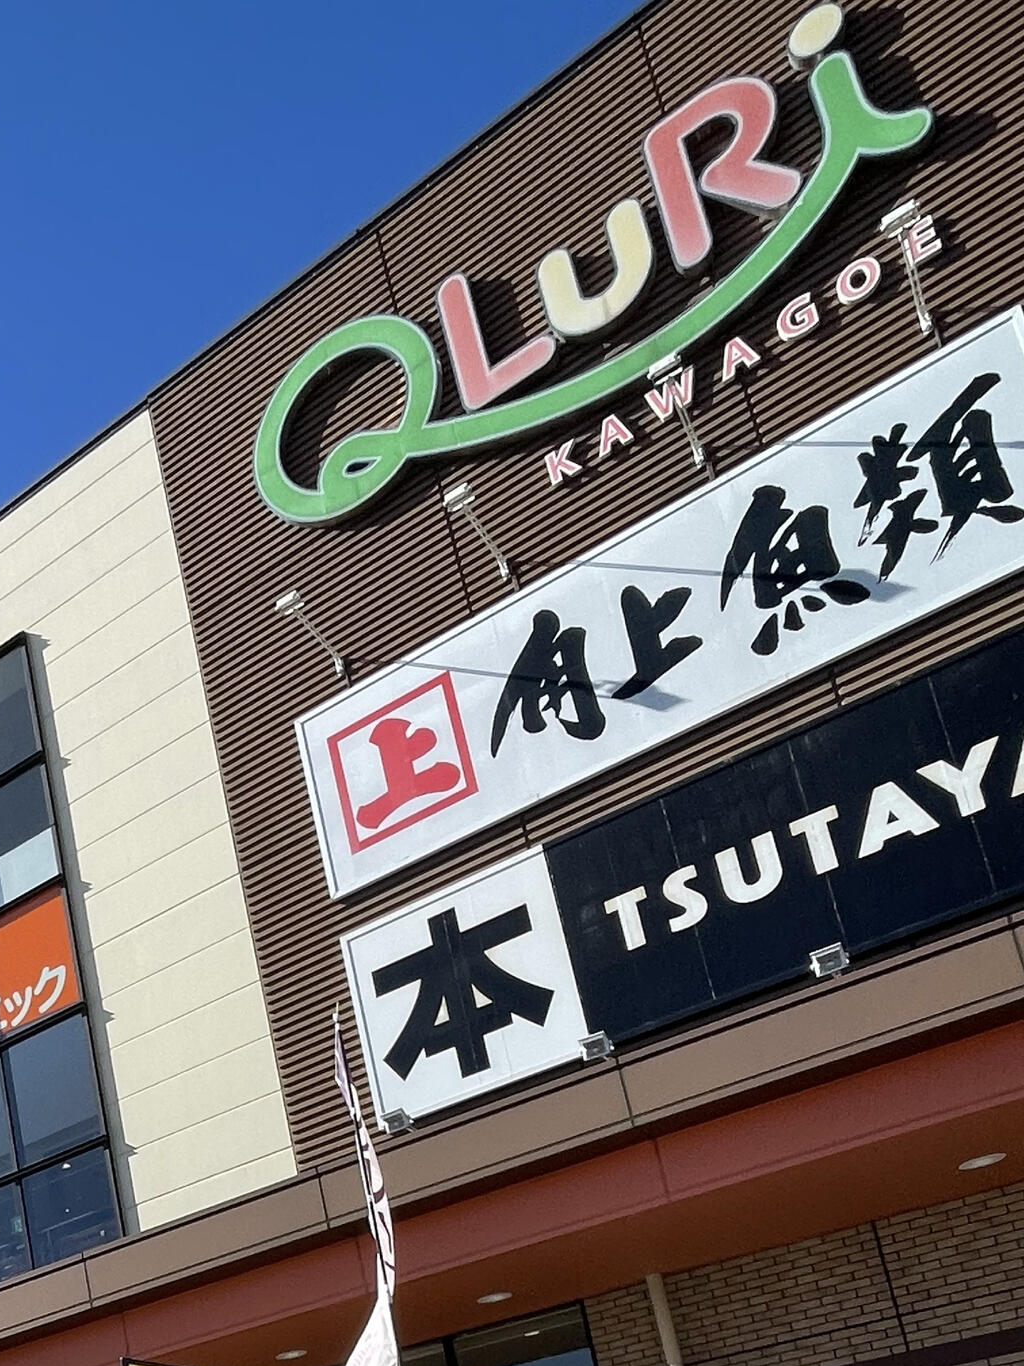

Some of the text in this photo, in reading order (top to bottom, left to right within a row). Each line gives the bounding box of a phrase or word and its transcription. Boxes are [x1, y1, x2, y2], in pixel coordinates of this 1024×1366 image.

[543, 214, 944, 486] KAWAGOE
[490, 372, 1024, 759] 角上魚類
[370, 902, 555, 1082] 本
